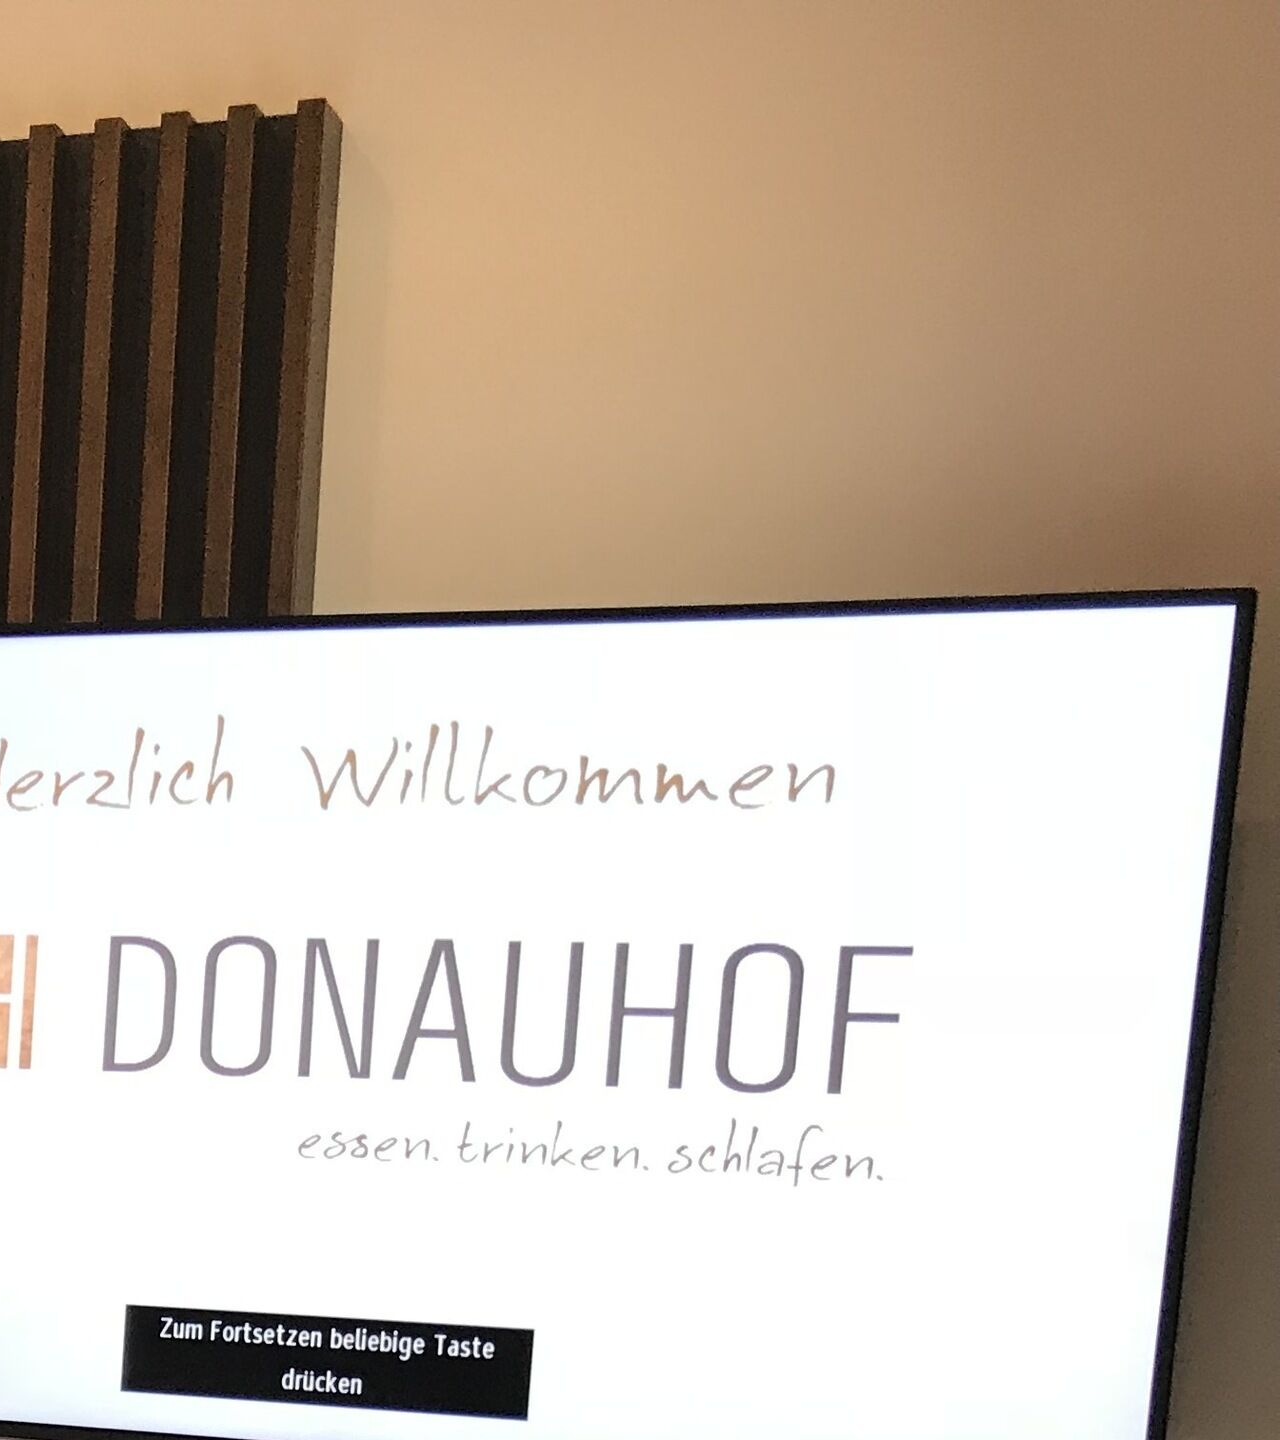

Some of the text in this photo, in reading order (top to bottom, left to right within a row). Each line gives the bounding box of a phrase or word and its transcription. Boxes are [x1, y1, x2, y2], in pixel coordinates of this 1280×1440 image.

[300, 719, 837, 812] Willkommen
[101, 934, 915, 1095] DONAUHOF
[297, 1117, 885, 1187] essen. trinken. schlafen.
[159, 1316, 496, 1362] Zum Fortsetzen beliebige Taste
[281, 1367, 364, 1396] drücken
